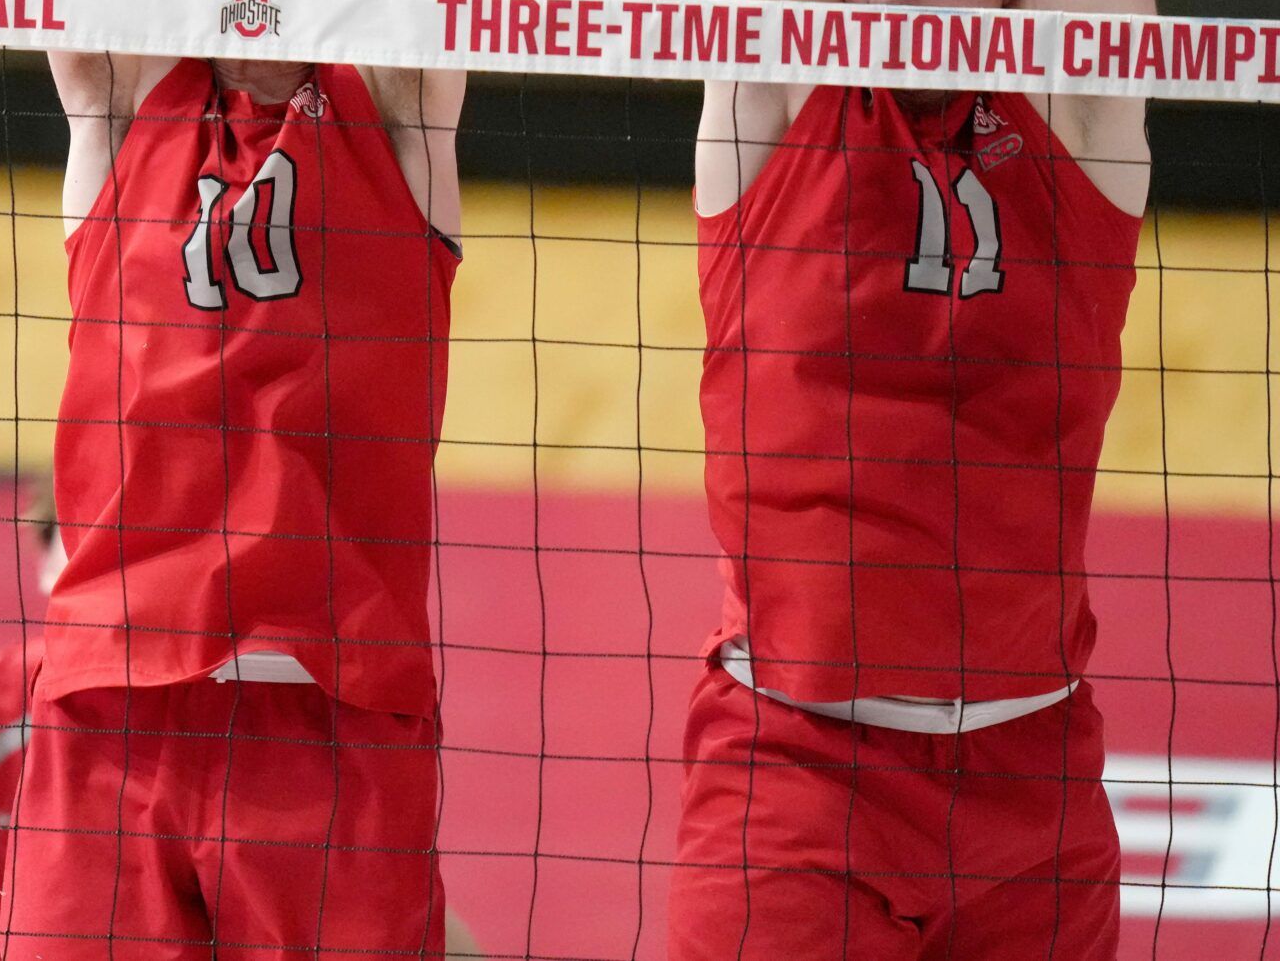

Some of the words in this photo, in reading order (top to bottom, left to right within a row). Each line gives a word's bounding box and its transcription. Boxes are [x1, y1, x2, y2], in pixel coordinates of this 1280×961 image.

[781, 8, 1045, 76] NATIONAL
[1062, 19, 1280, 83] CHAMPI
[182, 148, 304, 312] 10
[903, 156, 1006, 300] 11
